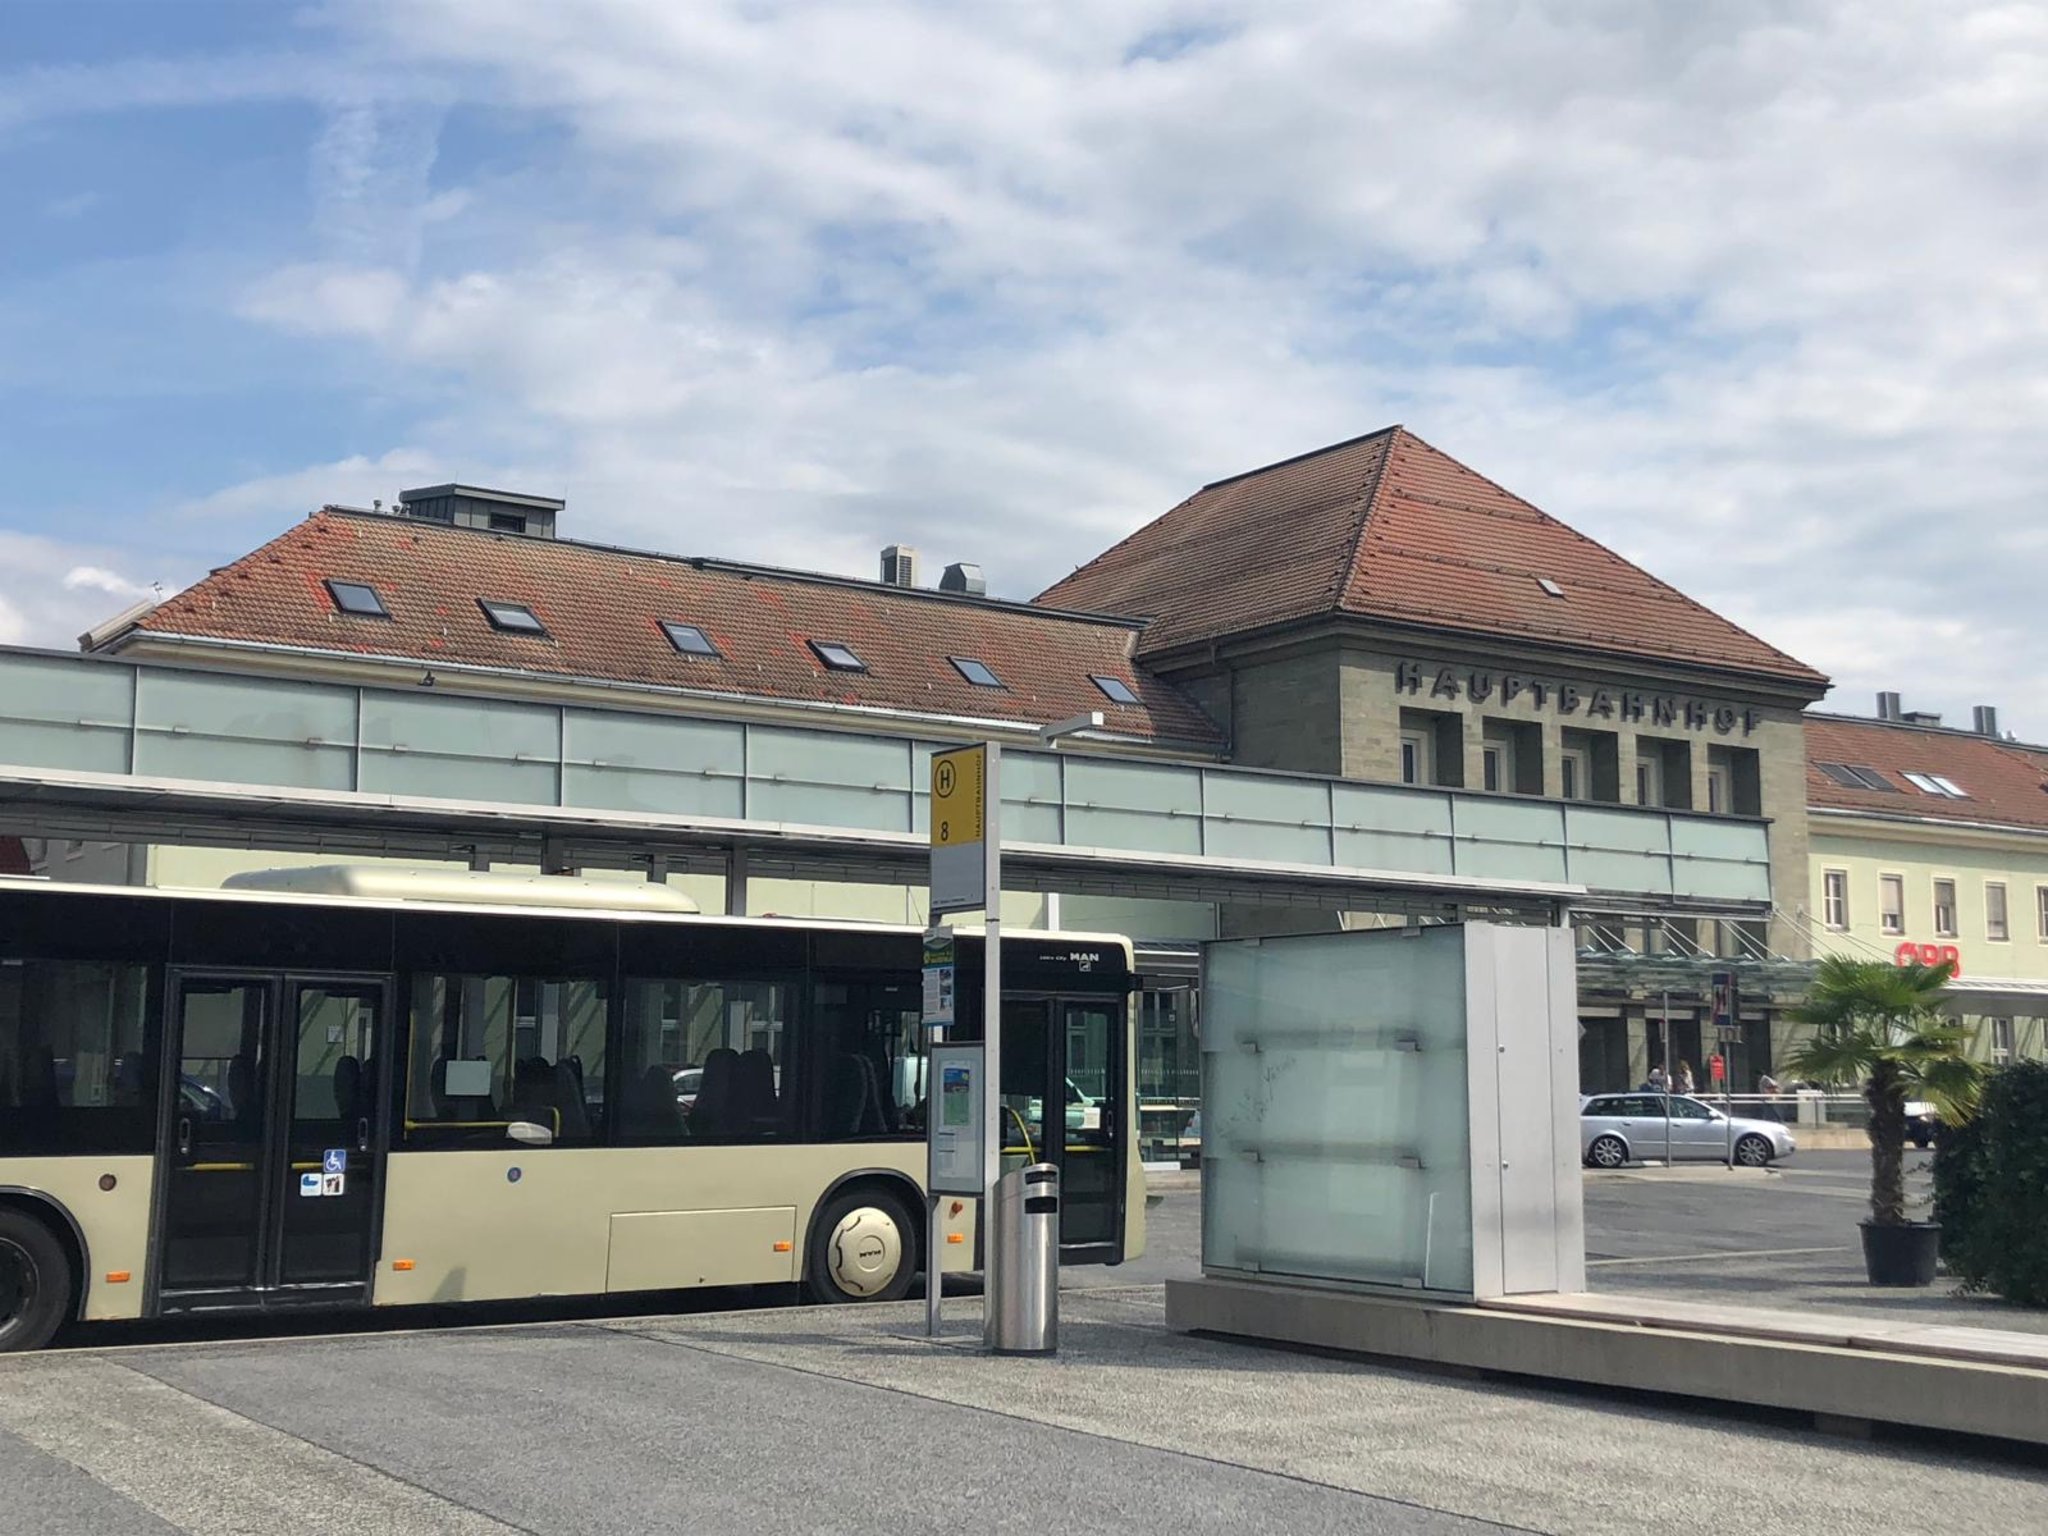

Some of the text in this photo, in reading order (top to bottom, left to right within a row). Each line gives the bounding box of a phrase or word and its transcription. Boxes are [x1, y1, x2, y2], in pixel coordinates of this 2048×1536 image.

[1395, 661, 1761, 738] HAUPTBAHNHOF
[940, 768, 950, 790] H
[941, 821, 949, 841] 8
[1069, 952, 1099, 962] MAN
